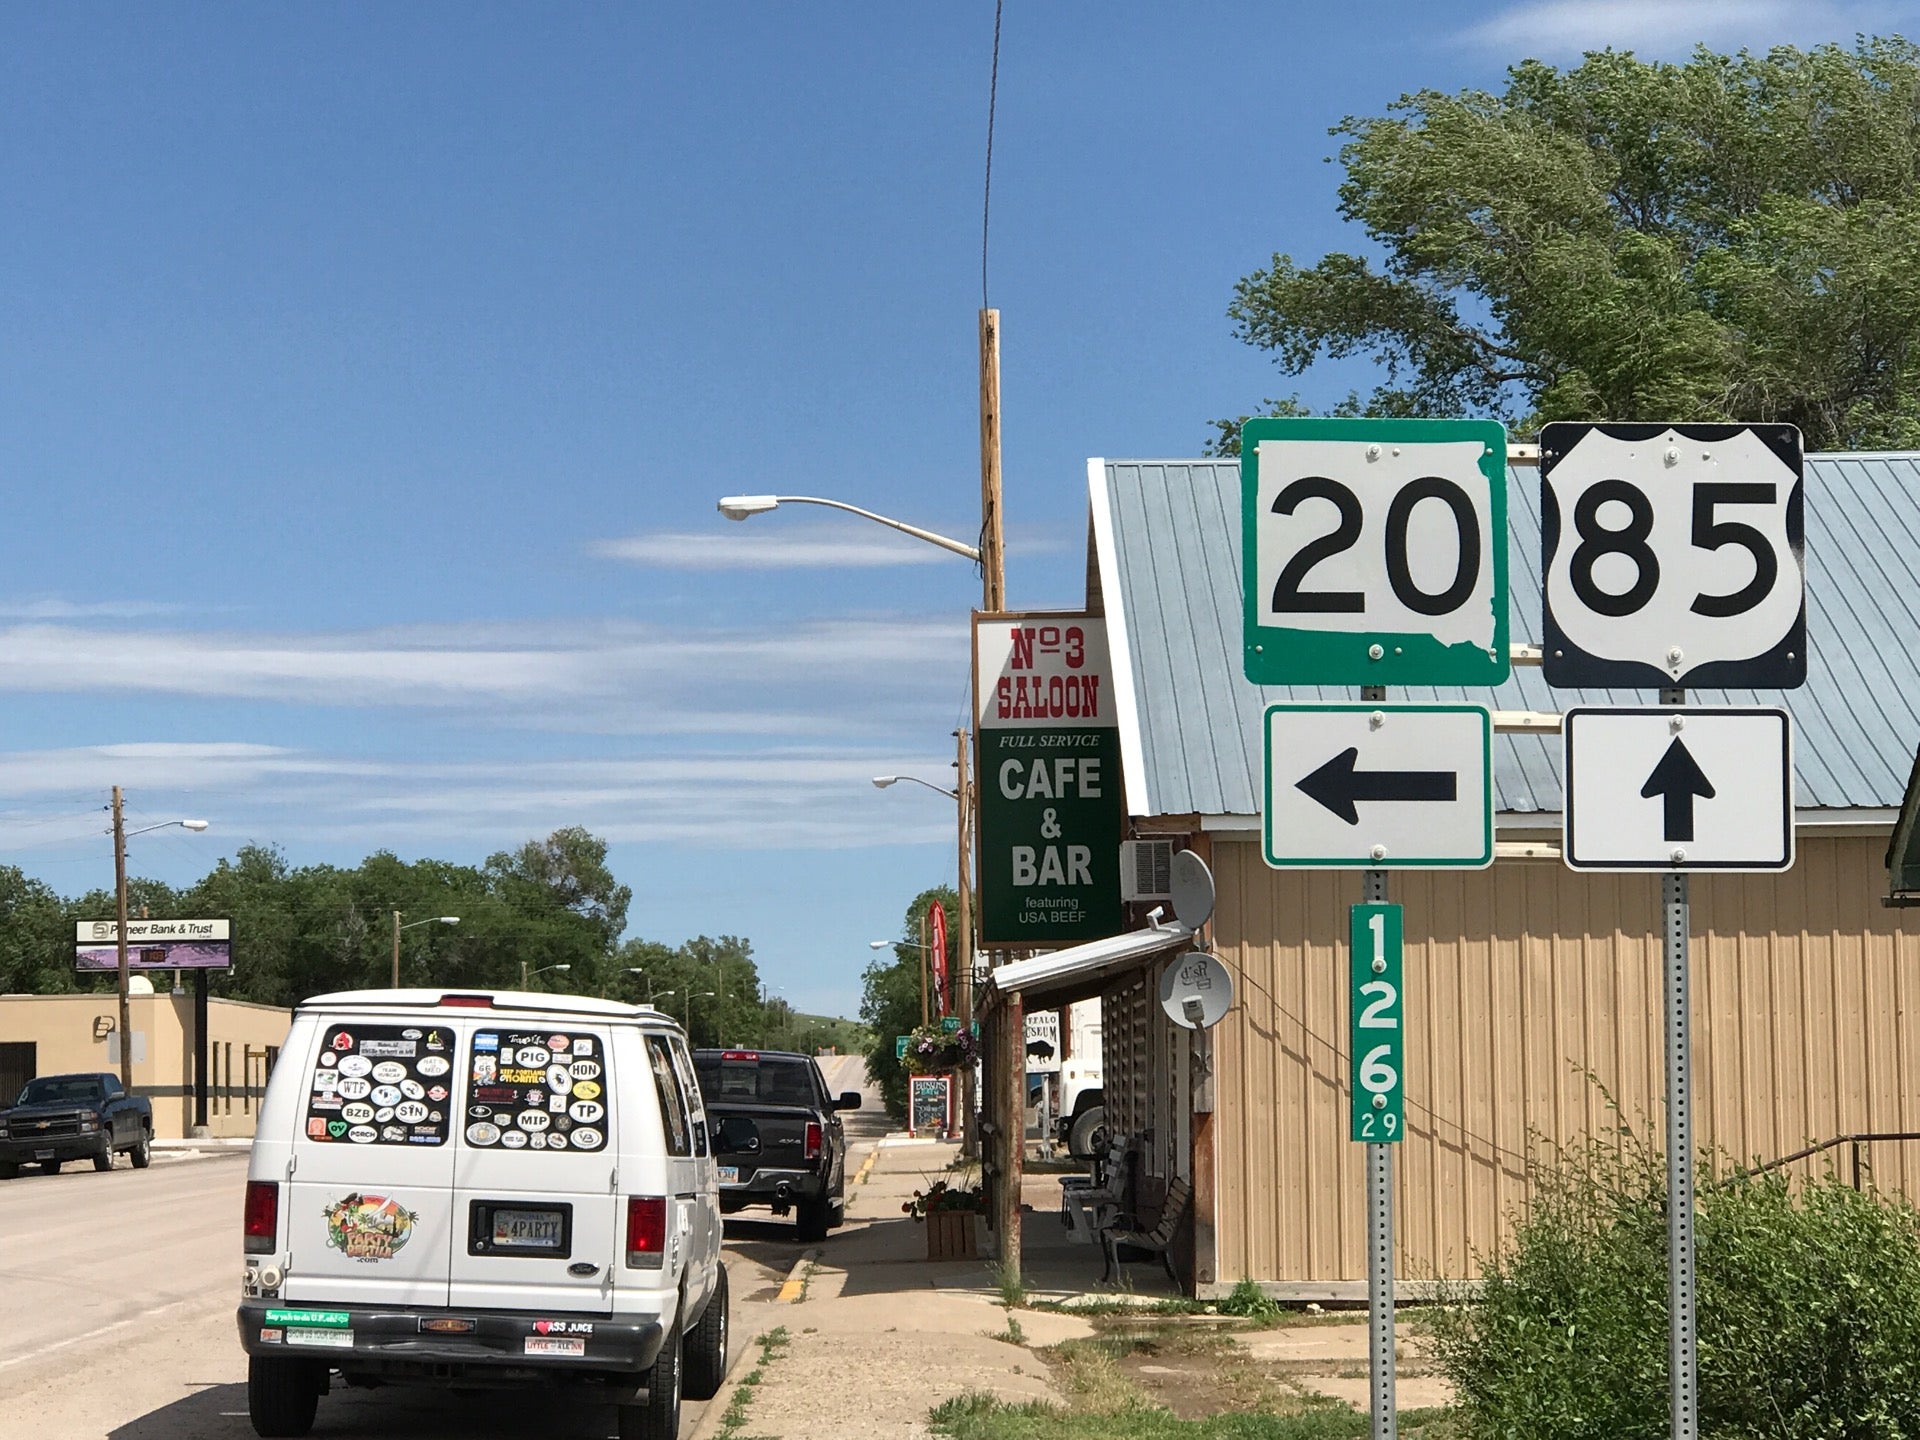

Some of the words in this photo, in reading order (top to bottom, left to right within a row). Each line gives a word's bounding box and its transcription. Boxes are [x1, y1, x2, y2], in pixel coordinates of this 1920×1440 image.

[1270, 476, 1481, 616] 20
[1569, 479, 1778, 618] 85
[997, 674, 1100, 720] SALOON
[999, 736, 1036, 749] FULL
[1039, 734, 1101, 748] SERVICE
[998, 757, 1102, 801] CAFE
[1040, 807, 1062, 840] &
[1012, 844, 1093, 887] BAR
[1025, 896, 1079, 911] featuring
[1018, 911, 1047, 924] USA
[1050, 910, 1086, 923] BEEF
[110, 924, 148, 935] Pneer
[150, 923, 176, 934] Bank
[178, 924, 186, 933] &
[188, 923, 213, 933] Trust
[1025, 1026, 1057, 1043] USEUM
[521, 1052, 545, 1063] PIG
[572, 1064, 597, 1076] HON
[343, 1081, 366, 1094] WTF
[346, 1108, 370, 1118] BZB
[577, 1104, 597, 1118] TP
[521, 1115, 548, 1126] MIP
[350, 1130, 376, 1138] PORCH
[510, 1220, 558, 1239] 4PARTY
[347, 1232, 393, 1250] PARTY
[532, 1322, 536, 1331] I
[548, 1321, 567, 1333] ASS
[568, 1323, 594, 1333] JUICE
[527, 1341, 549, 1350] LITTLE
